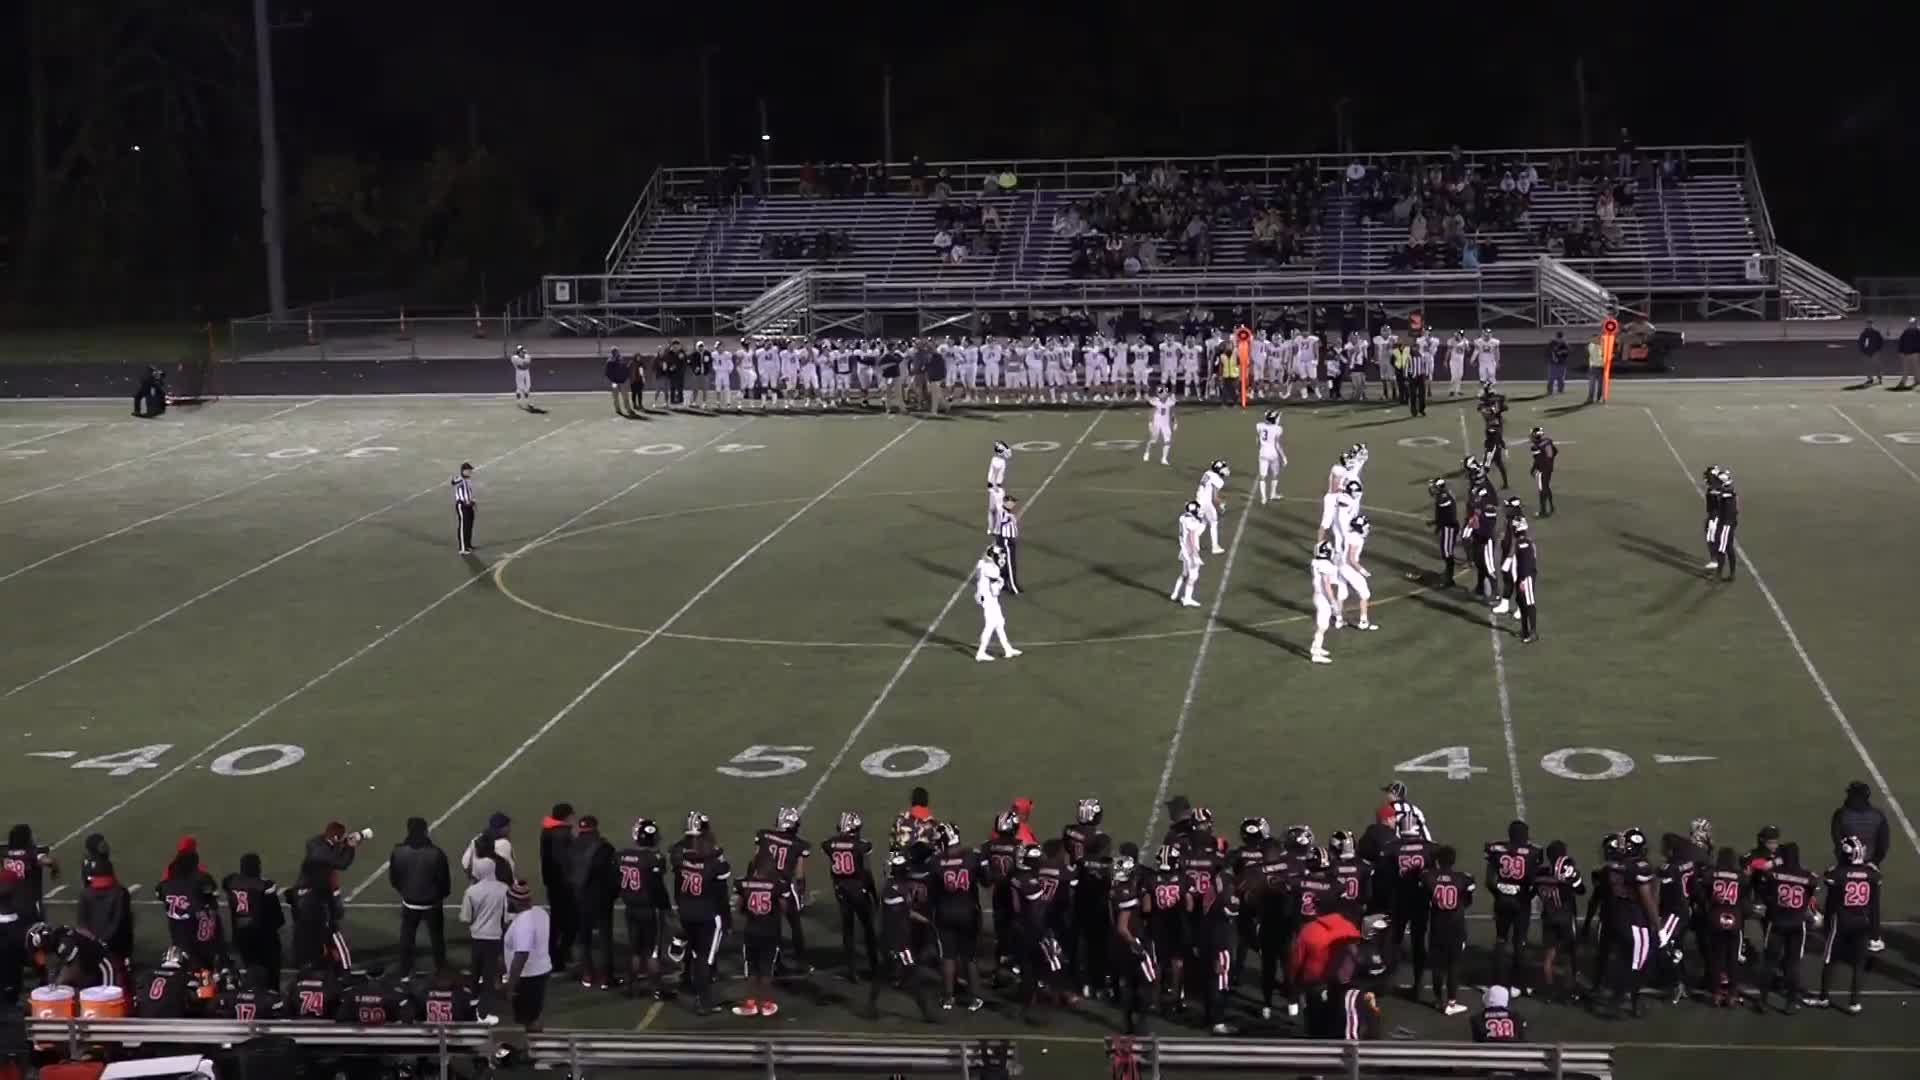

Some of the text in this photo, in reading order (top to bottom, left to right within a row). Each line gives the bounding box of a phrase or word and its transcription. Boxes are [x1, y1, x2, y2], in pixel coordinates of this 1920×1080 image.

[1262, 430, 1269, 441] 3
[832, 851, 855, 875] 30
[620, 865, 641, 890] 79
[681, 870, 703, 896] 78
[748, 891, 772, 915] 45
[1433, 884, 1458, 910] 40
[1713, 880, 1739, 905] 24
[1777, 884, 1804, 909] 26
[1844, 881, 1870, 907] 29
[235, 1003, 256, 1023] 17
[299, 991, 324, 1017] 74
